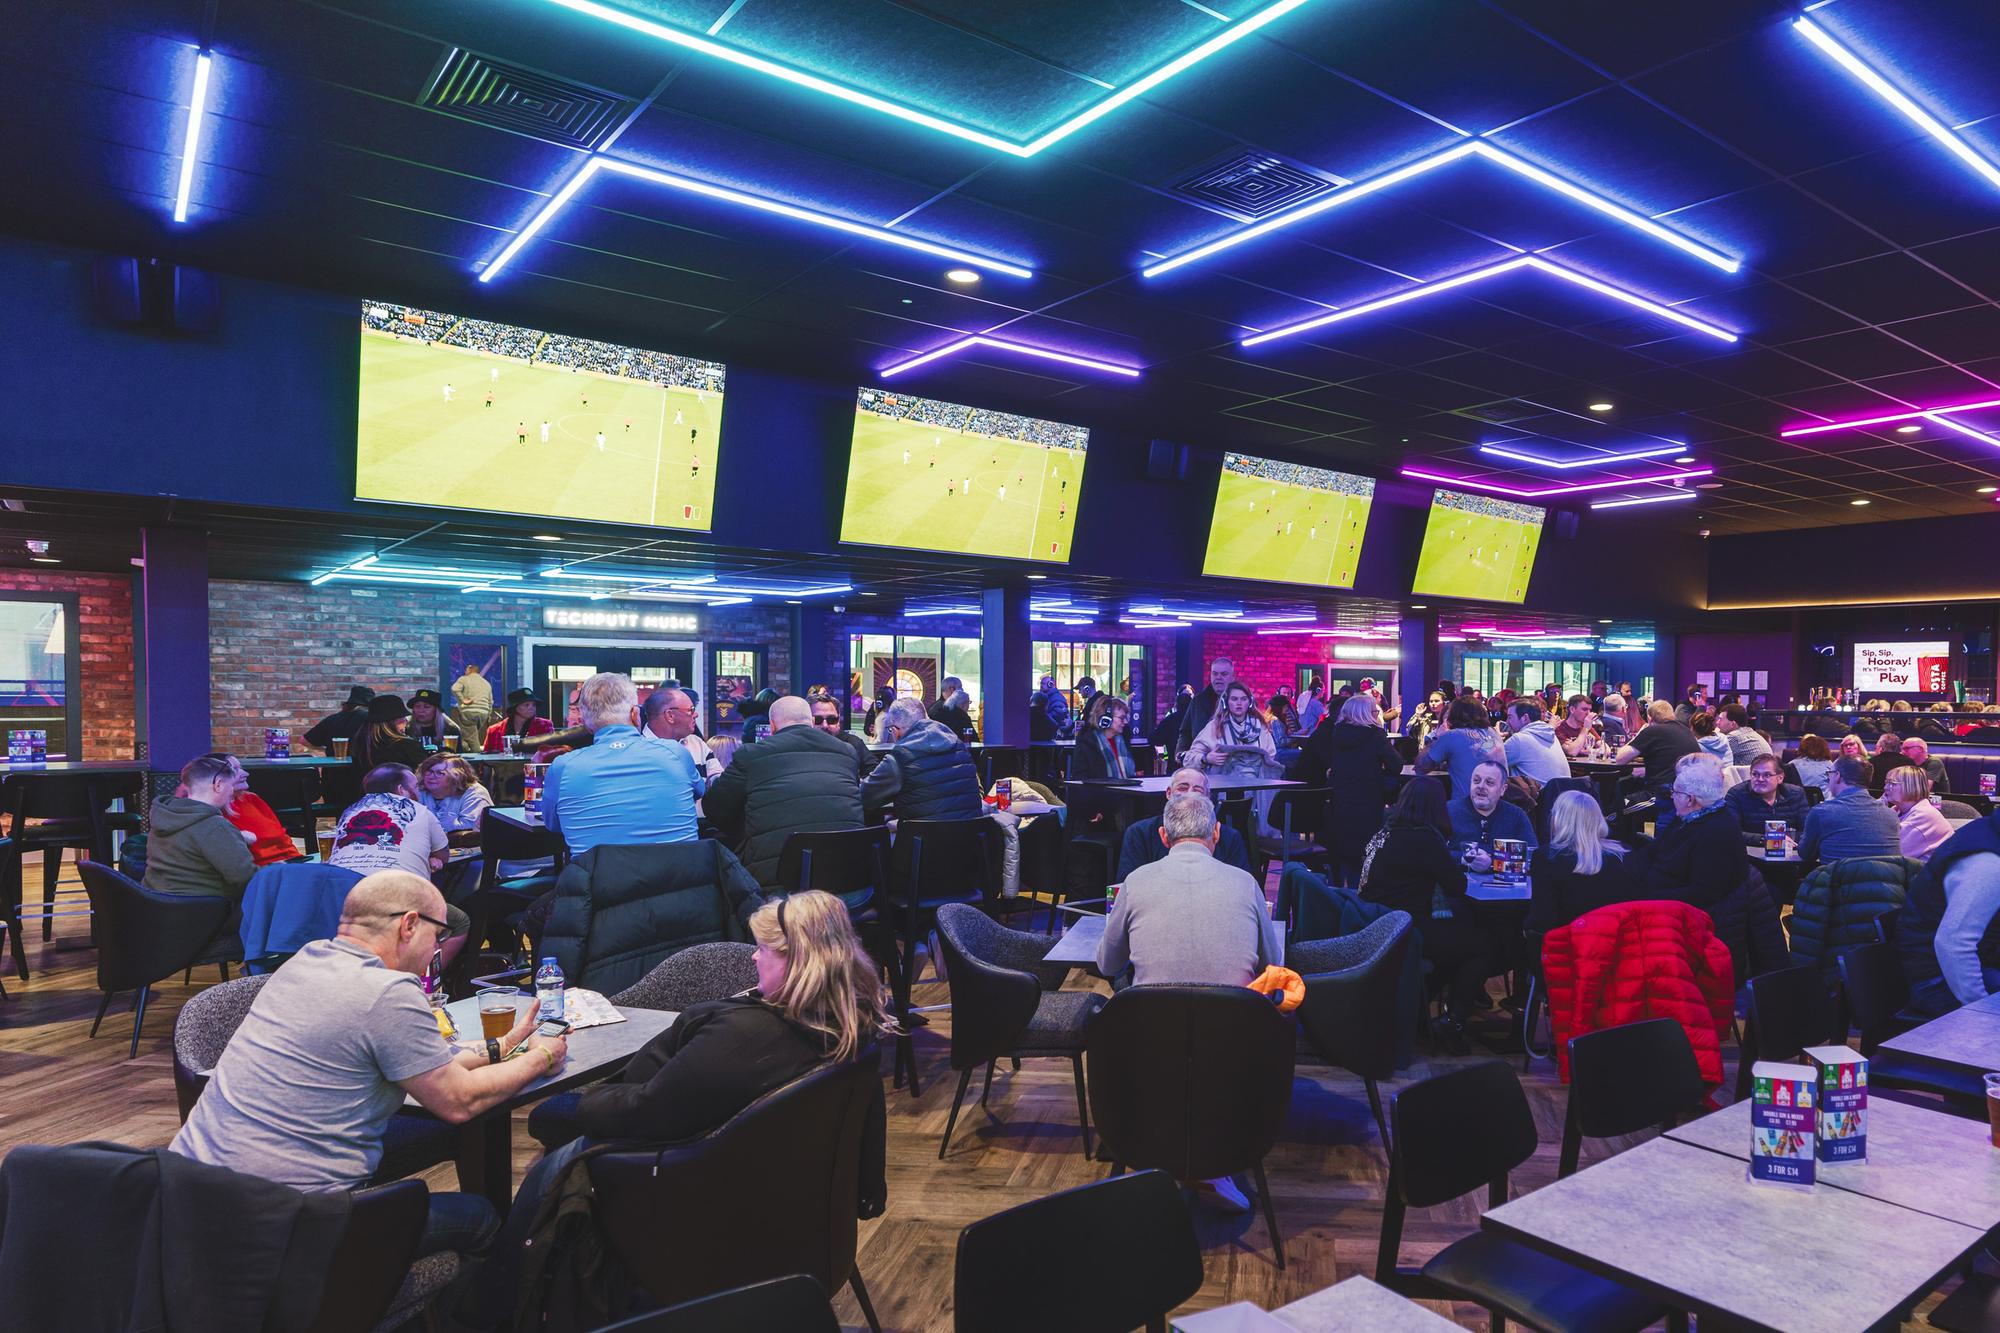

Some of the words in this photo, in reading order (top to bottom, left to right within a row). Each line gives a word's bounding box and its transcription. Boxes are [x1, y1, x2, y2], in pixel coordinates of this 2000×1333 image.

[546, 610, 639, 627] TECHPUTT
[643, 616, 697, 630] MUSIC
[1862, 649, 1877, 657] Sip,
[1878, 649, 1894, 657] Sip,
[1868, 657, 1912, 667] Hooray!
[1879, 672, 1909, 685] Play
[1930, 663, 1941, 692] OSTA
[1833, 1147, 1837, 1155] 3
[1838, 1146, 1847, 1154] FOR
[1848, 1145, 1856, 1153] £14
[1768, 1165, 1772, 1173] 3
[1774, 1165, 1785, 1175] FOR
[1787, 1167, 1798, 1176] £14
